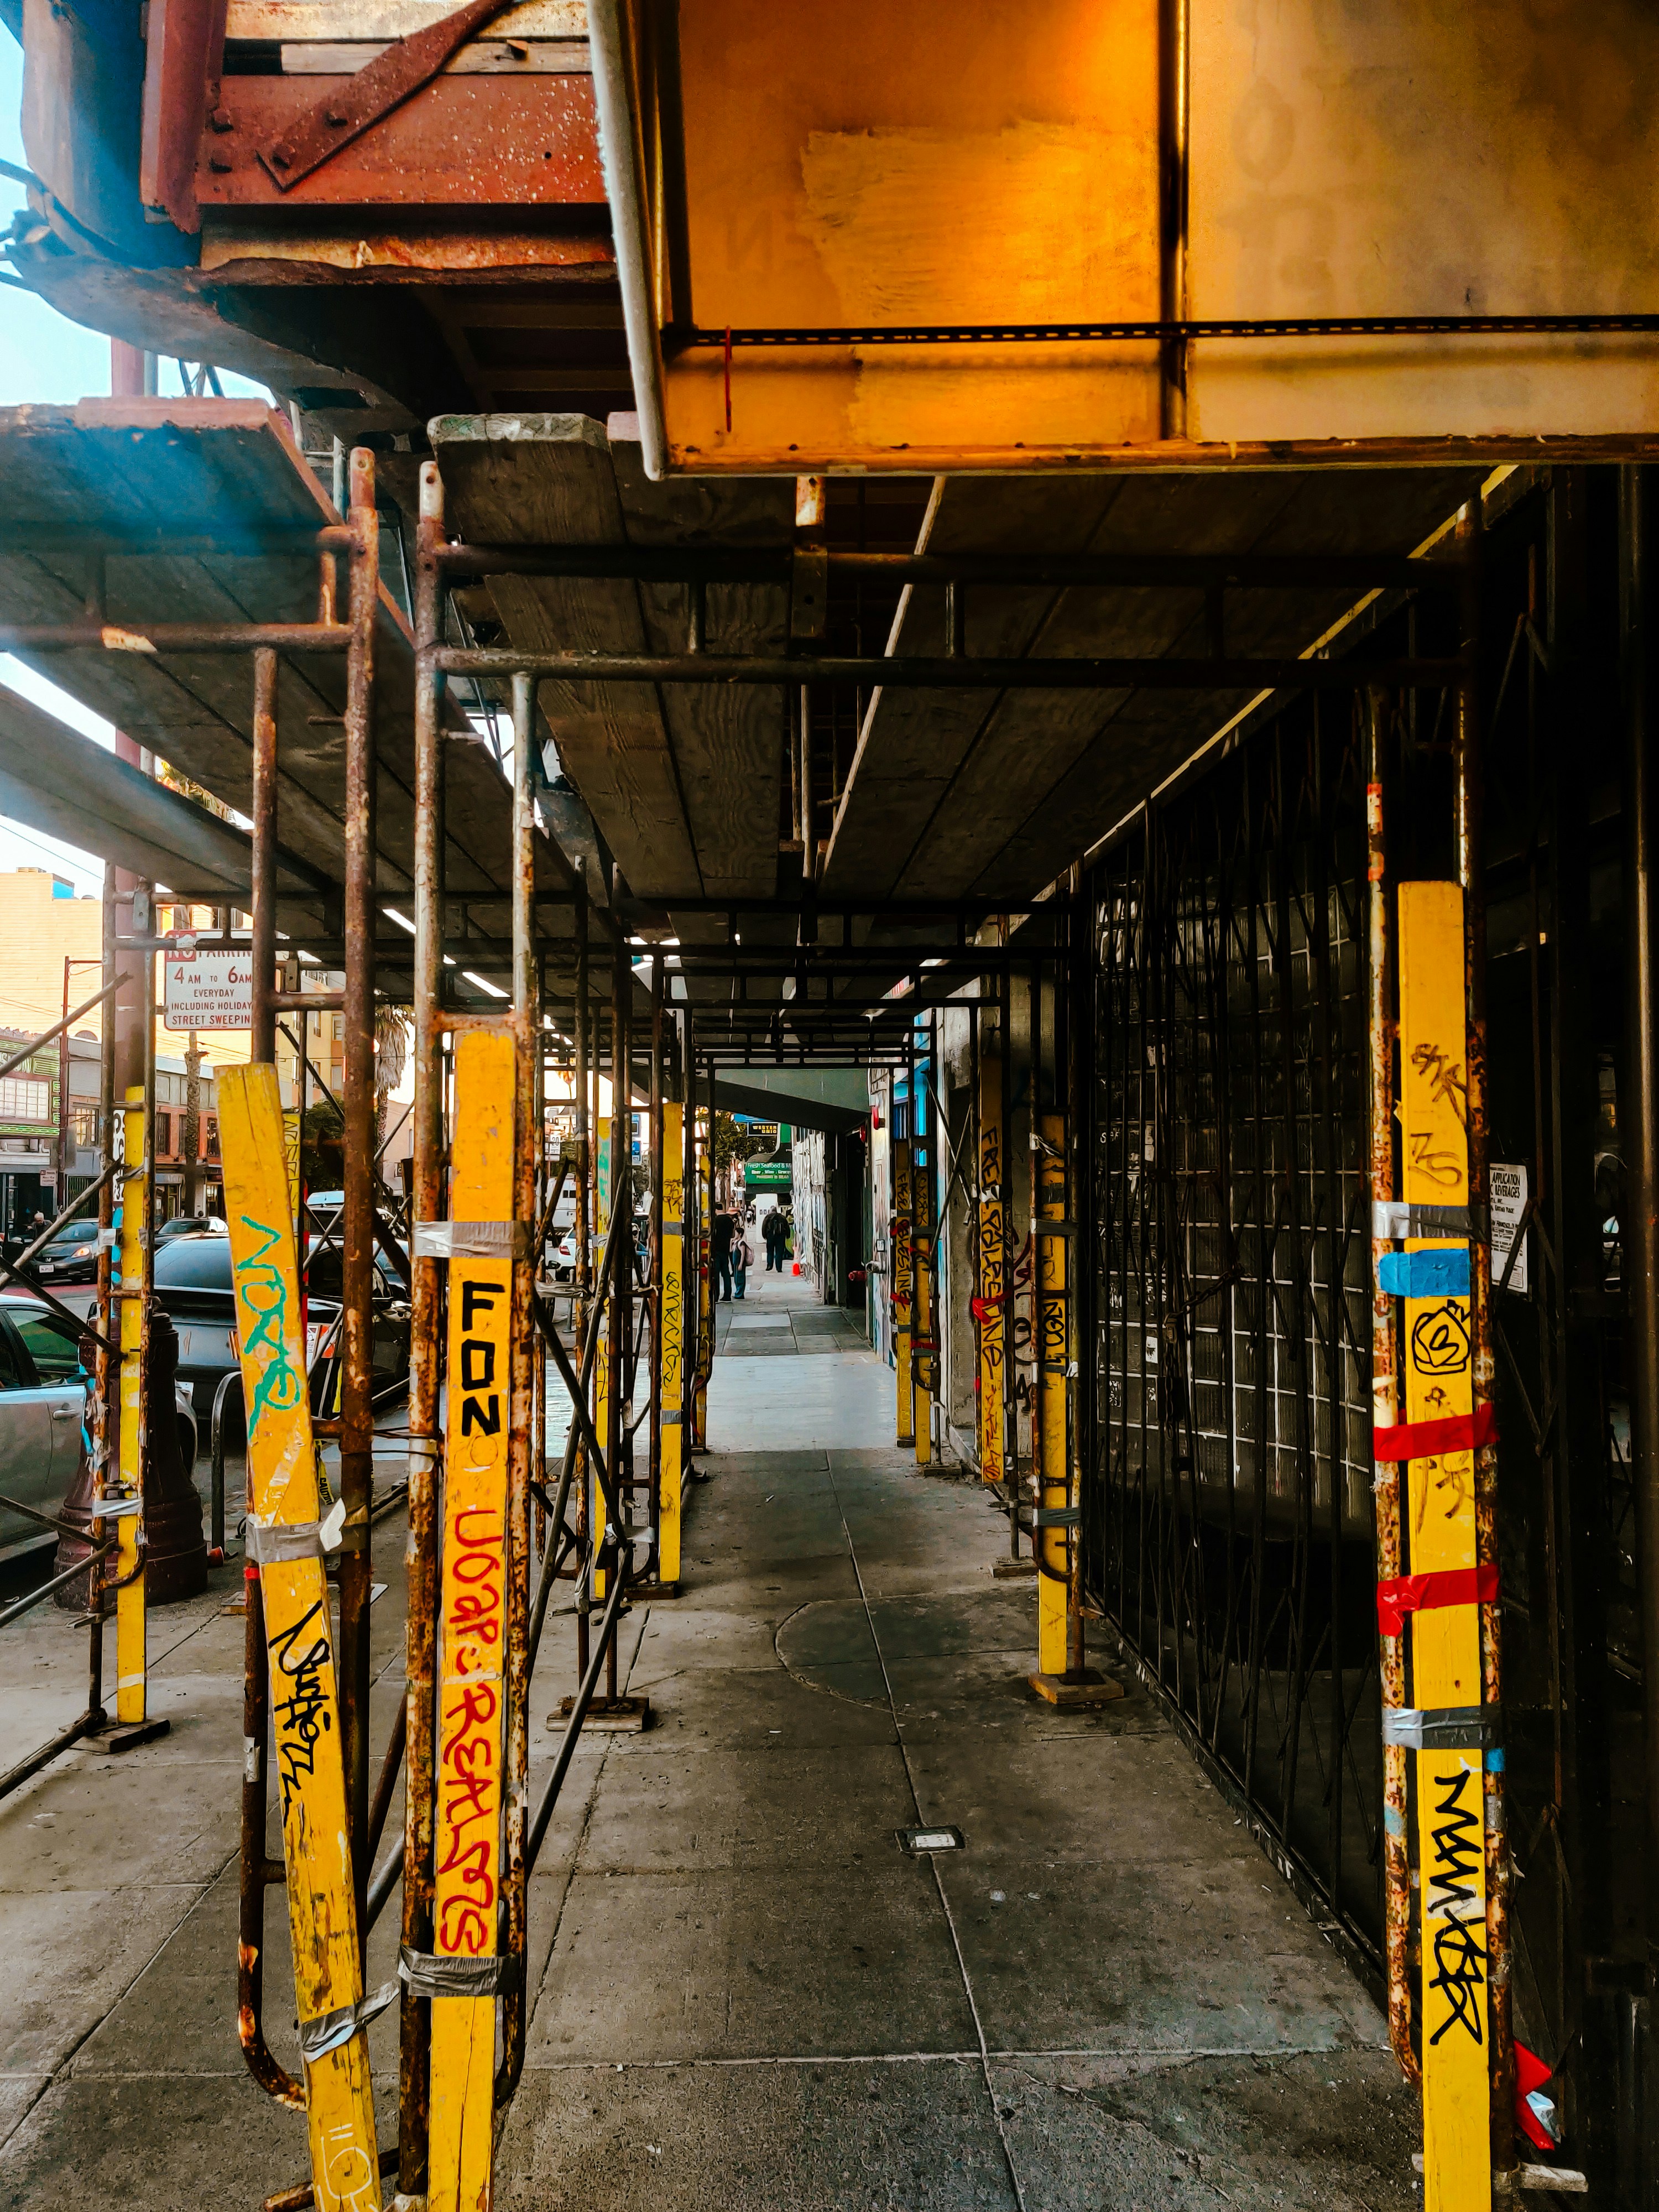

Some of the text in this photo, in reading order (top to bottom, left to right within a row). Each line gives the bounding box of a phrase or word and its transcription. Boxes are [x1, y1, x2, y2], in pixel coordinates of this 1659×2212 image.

[174, 966, 184, 984] 4
[188, 974, 201, 984] AM
[194, 989, 234, 998] EVERYDAY
[171, 1001, 253, 1011] INCLUDING HOLIDAY
[172, 1015, 250, 1025] STREET SWEEPIN
[1492, 1172, 1521, 1186] APPLICATION
